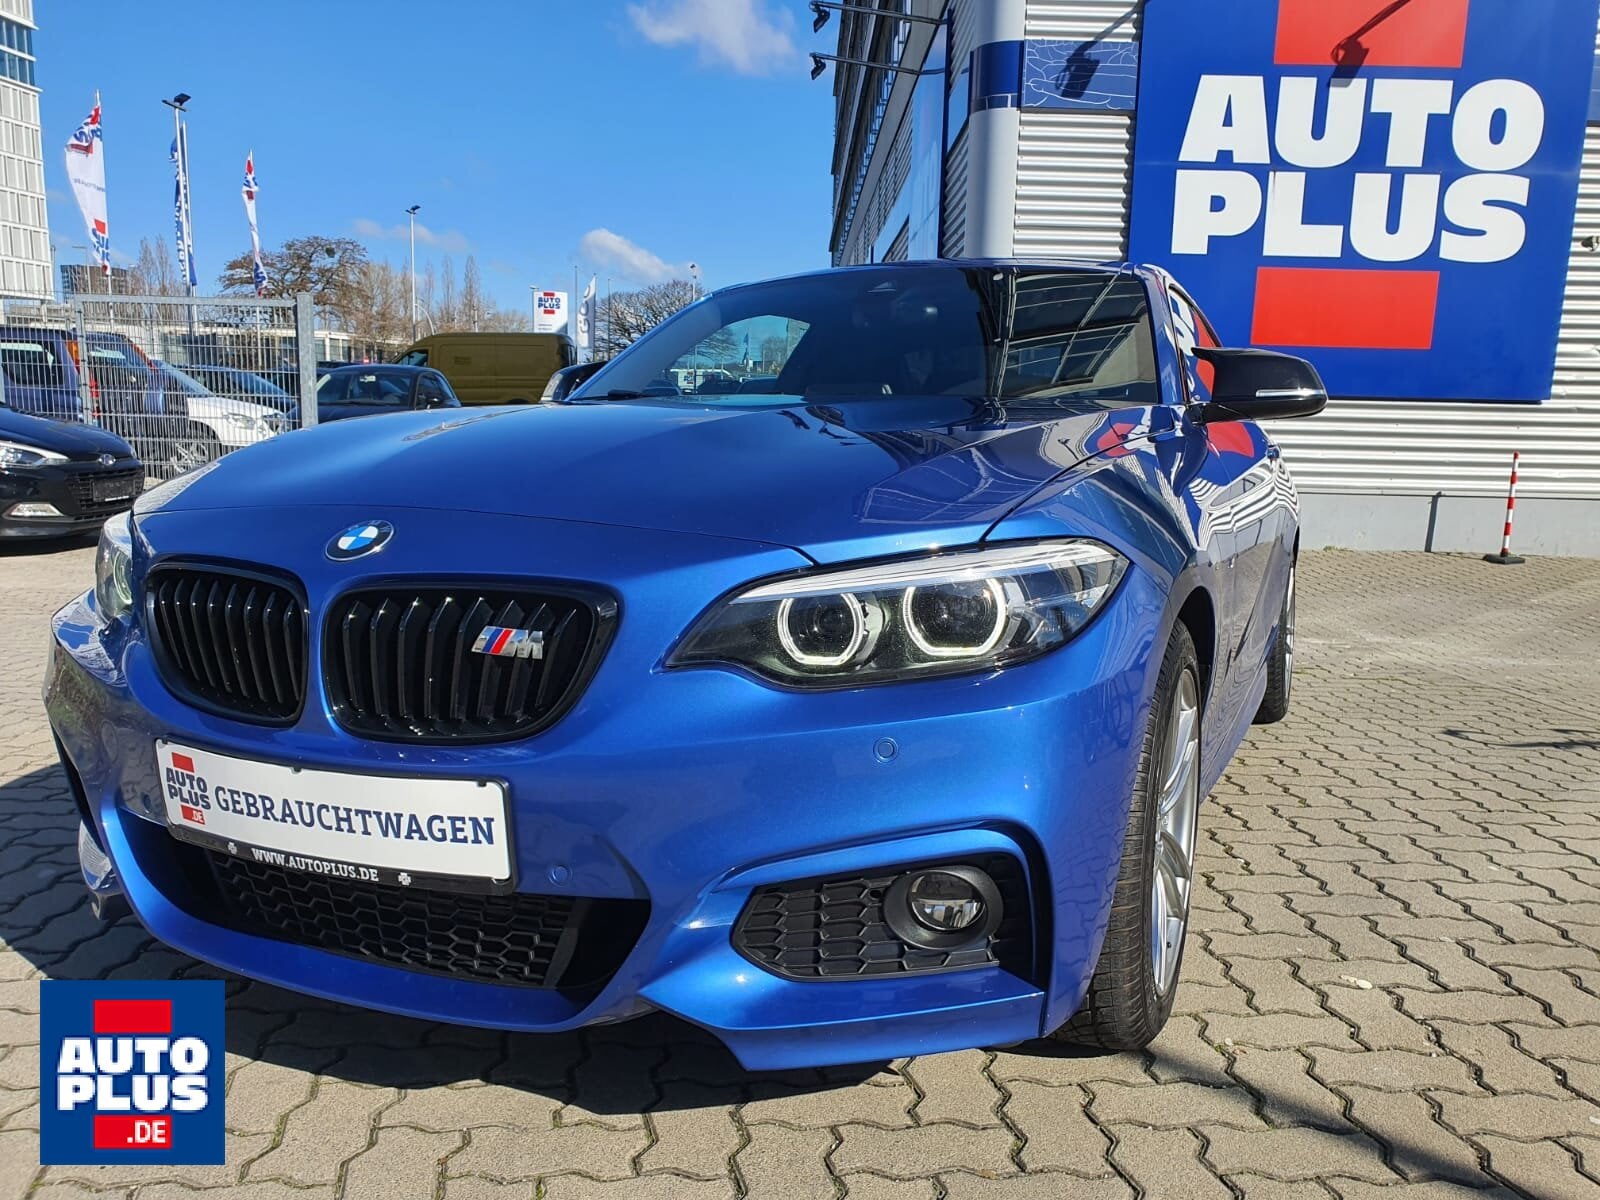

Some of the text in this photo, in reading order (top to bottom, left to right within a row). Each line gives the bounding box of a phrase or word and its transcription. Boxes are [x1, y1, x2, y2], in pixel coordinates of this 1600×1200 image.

[1177, 74, 1545, 171] AUTO
[1171, 169, 1530, 263] PLUS
[166, 767, 208, 793] AUTO
[167, 783, 211, 810] PLUS
[214, 785, 495, 845] GEBRAUCHTWAGEN
[251, 847, 379, 882] WWW.AUTOPLUS.DE
